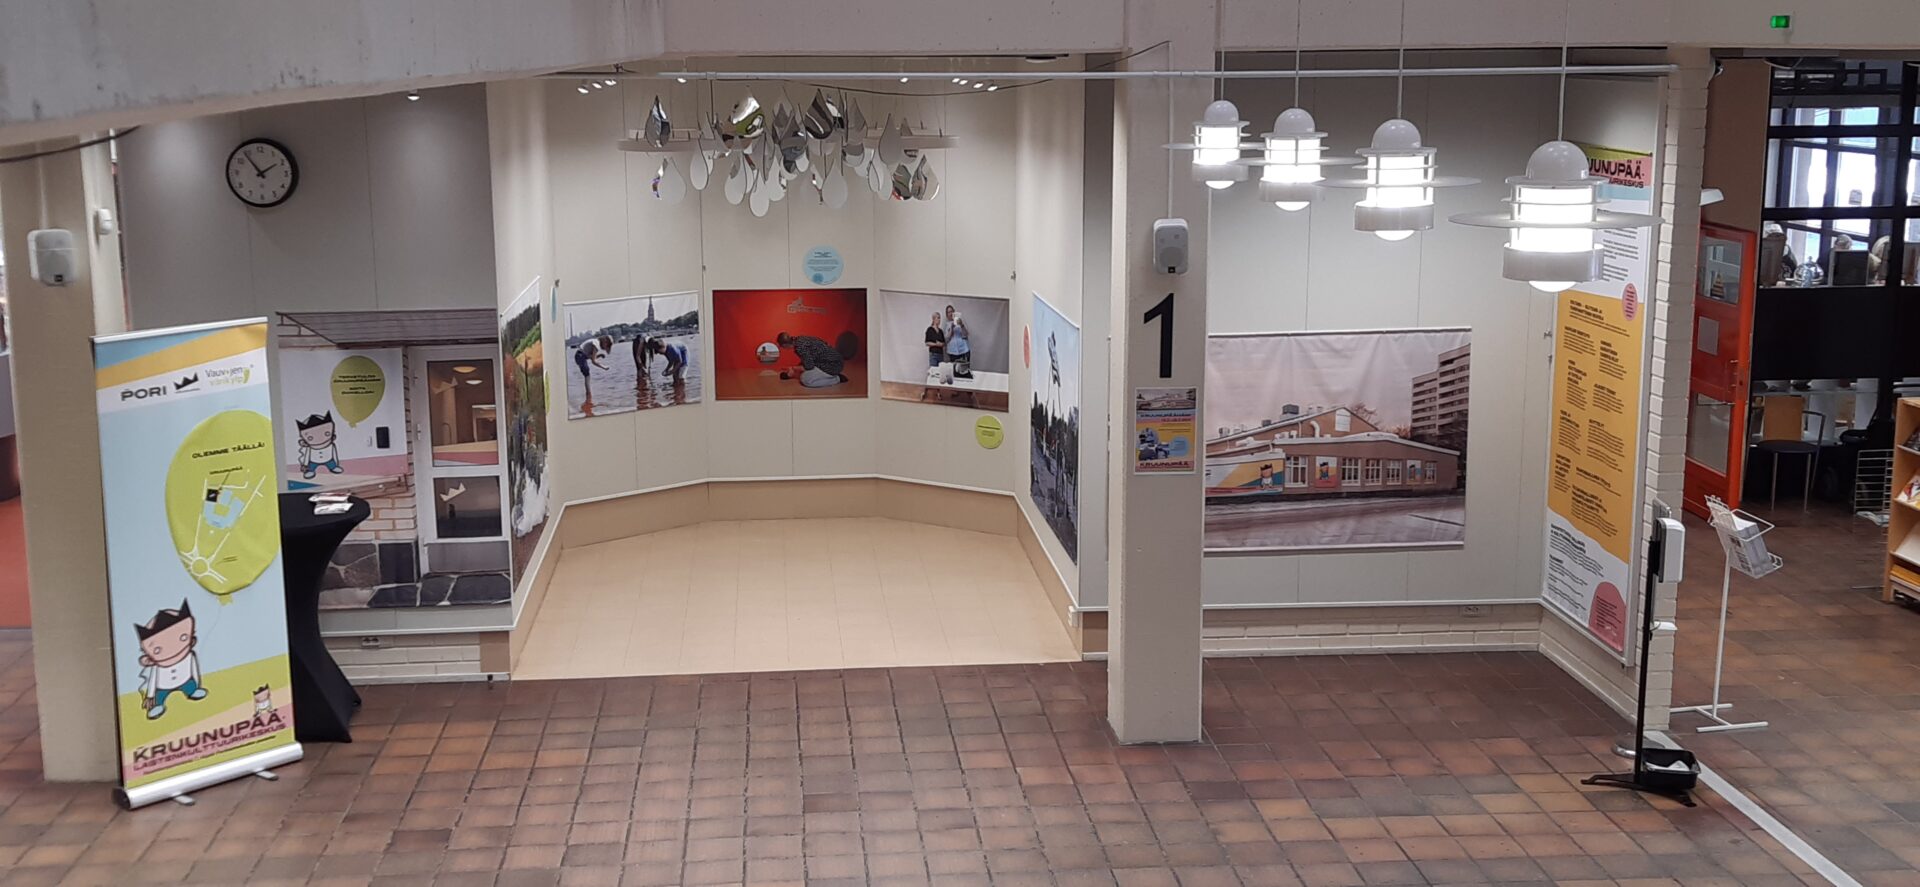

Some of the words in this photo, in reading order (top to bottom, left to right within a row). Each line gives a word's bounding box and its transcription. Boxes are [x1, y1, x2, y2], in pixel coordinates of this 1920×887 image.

[1144, 292, 1174, 379] 1
[121, 386, 167, 401] PORI
[192, 448, 229, 459] OLEMME
